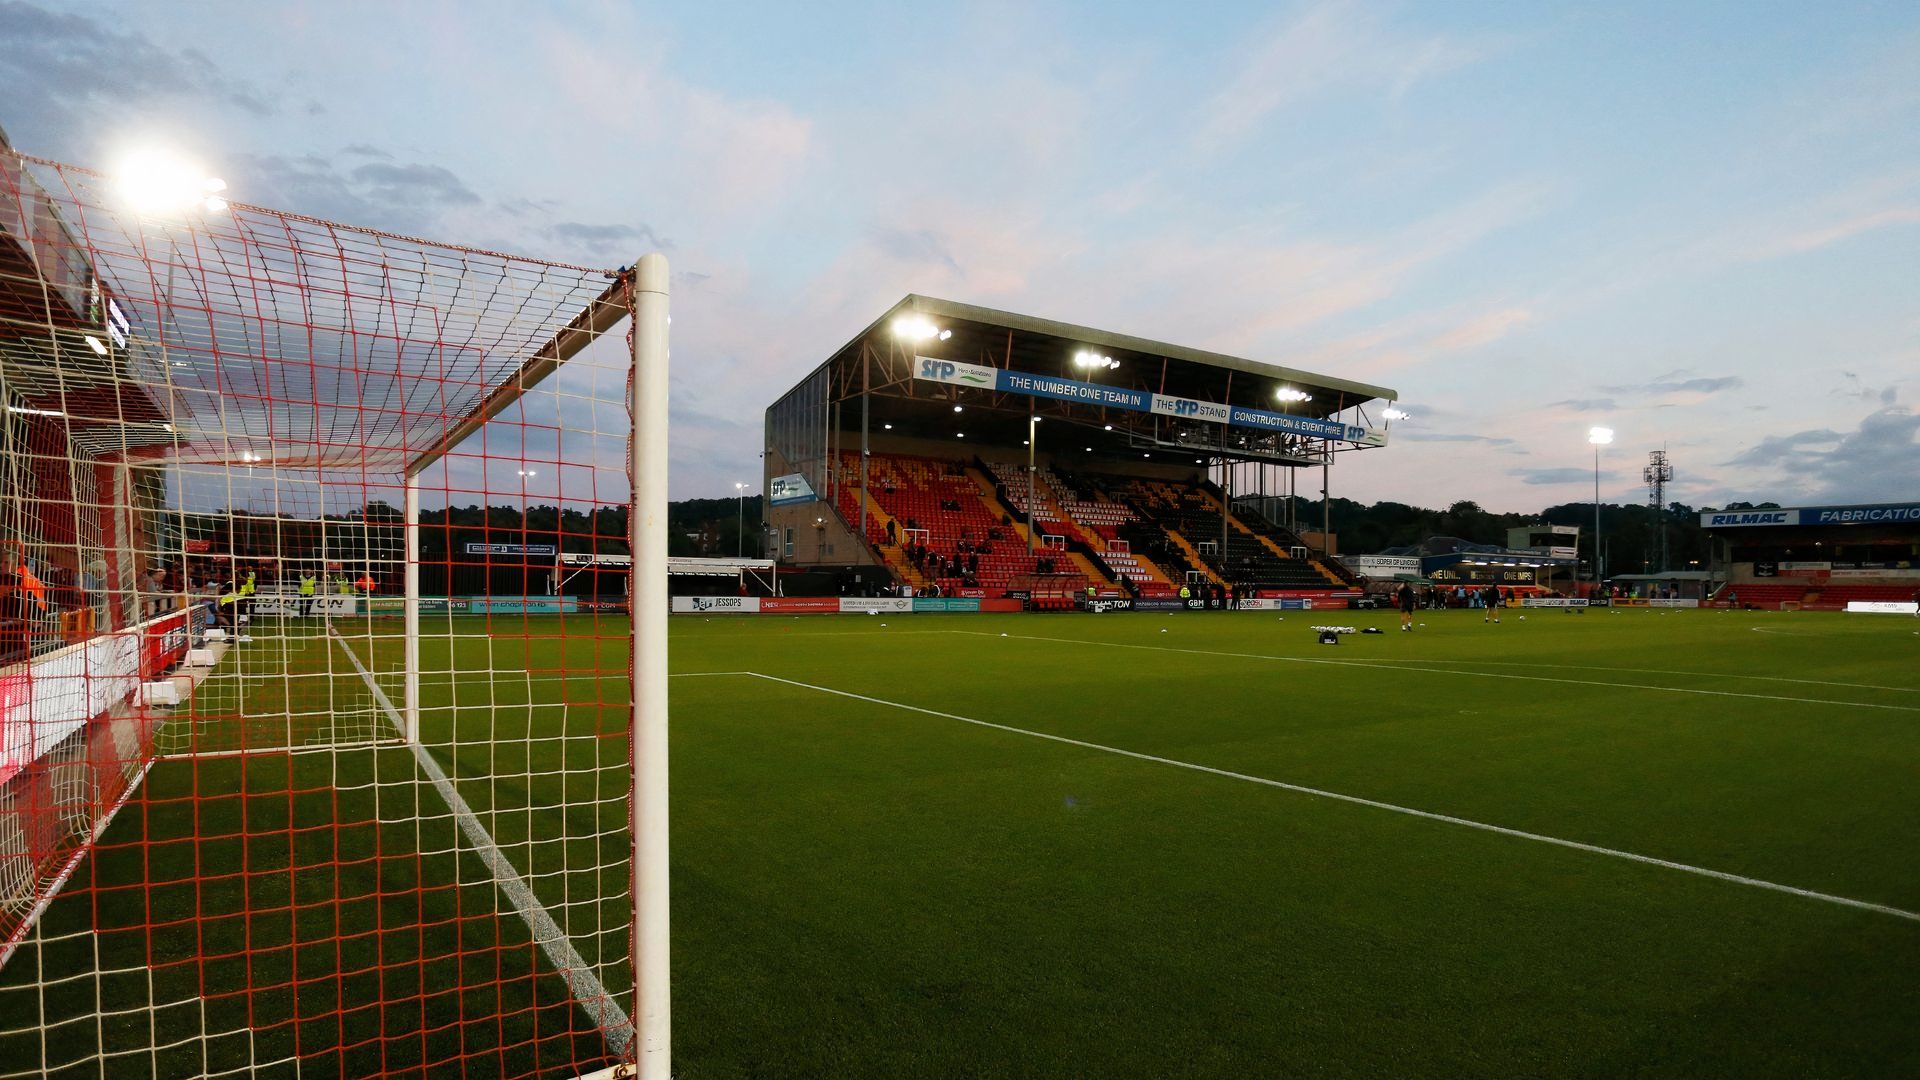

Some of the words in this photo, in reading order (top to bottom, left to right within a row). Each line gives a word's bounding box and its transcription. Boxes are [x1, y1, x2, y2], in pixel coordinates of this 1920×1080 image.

[1009, 376, 1031, 389] THE
[1033, 380, 1077, 397] NUMBER
[1079, 387, 1101, 400] ONE
[1103, 390, 1129, 404] TEAM
[1130, 395, 1141, 406] IN
[1156, 399, 1173, 411] THE
[1199, 405, 1227, 418] STAND
[1234, 411, 1294, 428] CONSTRUCTION
[1294, 420, 1301, 429] &
[1301, 421, 1325, 433] EVENT
[1324, 425, 1342, 436] HIRE
[1711, 512, 1788, 525] RILMAC
[1503, 571, 1517, 581] ONE
[715, 598, 742, 607] JESSOPS
[1188, 599, 1204, 607] GBM
